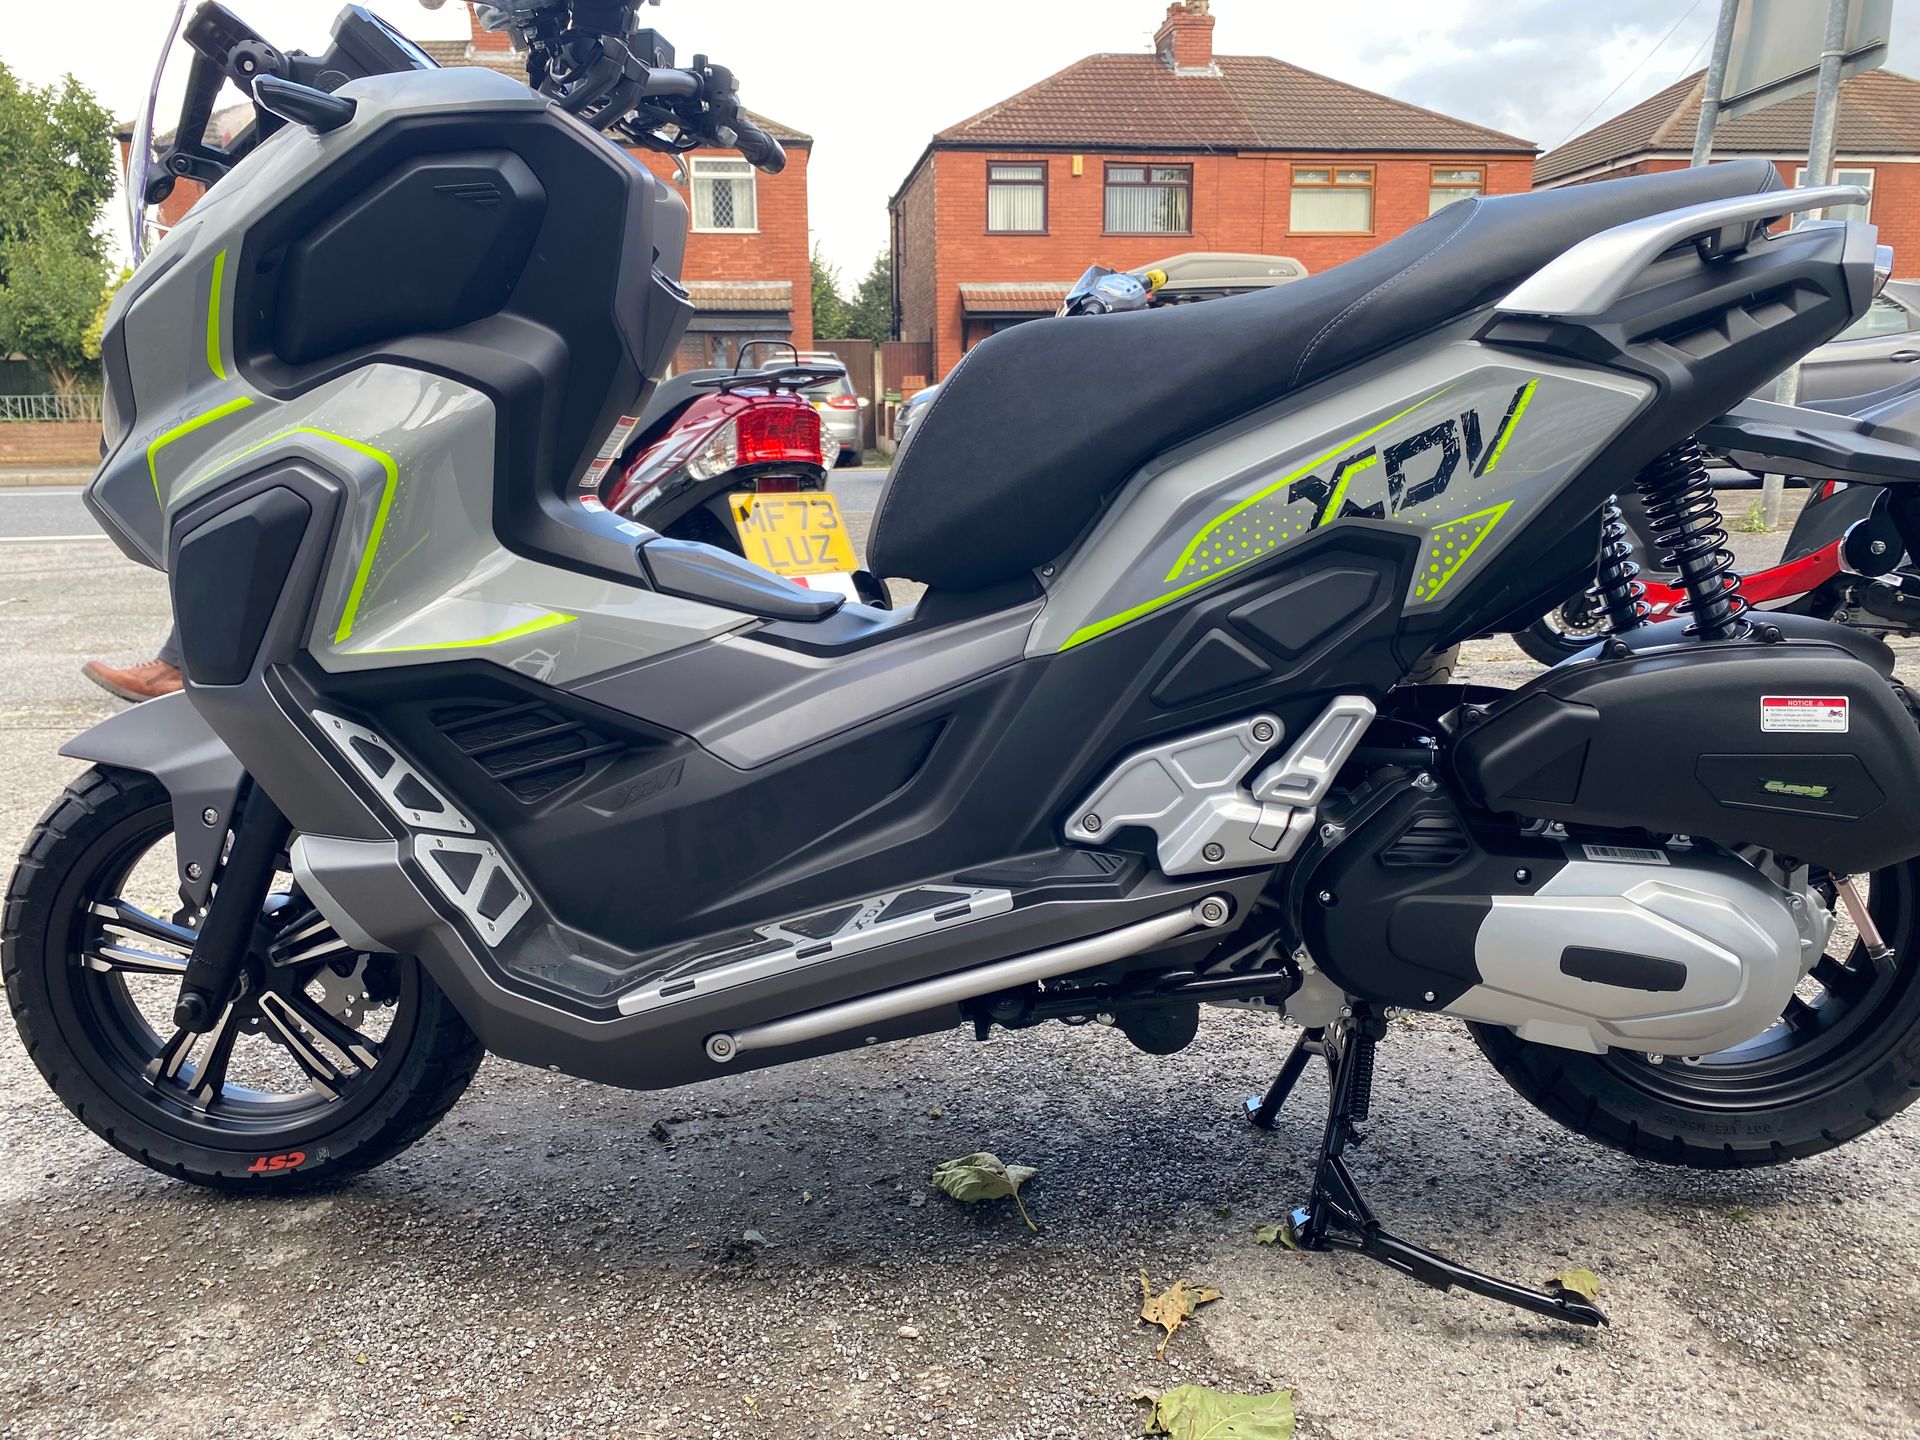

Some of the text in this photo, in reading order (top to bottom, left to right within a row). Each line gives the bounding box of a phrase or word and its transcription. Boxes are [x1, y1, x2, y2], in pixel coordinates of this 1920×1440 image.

[134, 406, 201, 451] EXTREME
[1287, 378, 1540, 534] XDV
[739, 500, 838, 534] MF73
[762, 534, 838, 568] LUZ
[247, 1152, 306, 1172] CST
